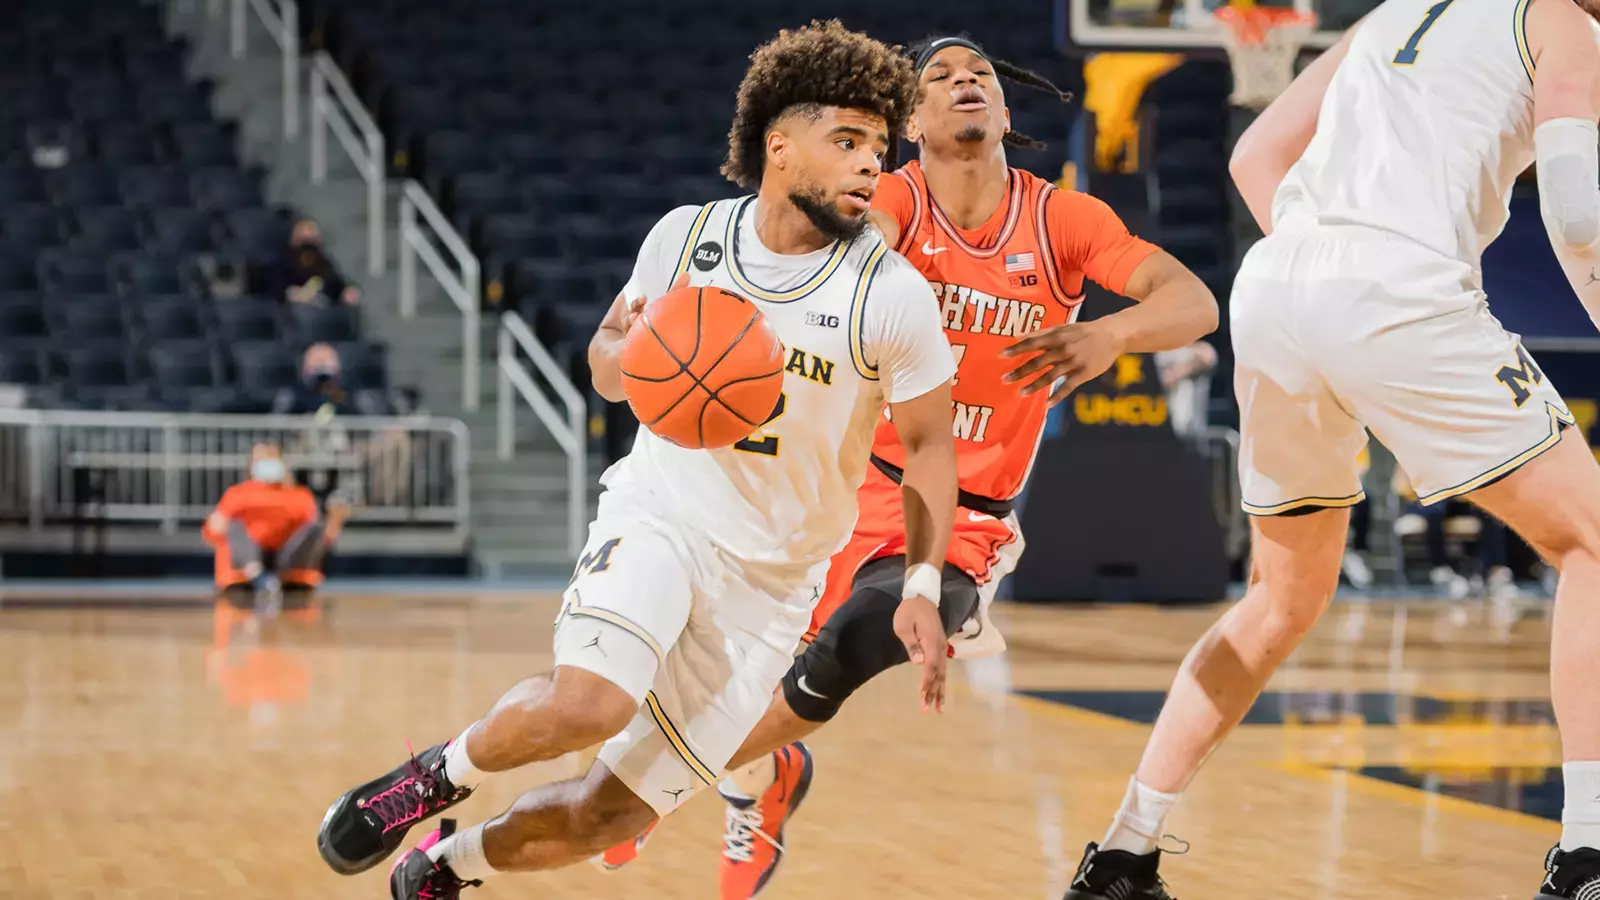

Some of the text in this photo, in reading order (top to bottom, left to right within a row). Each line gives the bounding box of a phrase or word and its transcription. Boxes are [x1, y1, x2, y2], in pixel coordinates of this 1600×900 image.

[1393, 0, 1455, 66] 1
[695, 249, 720, 263] BLM
[929, 280, 1046, 338] HTING
[781, 341, 835, 387] AN
[1494, 344, 1542, 409] M
[951, 400, 994, 443] NI
